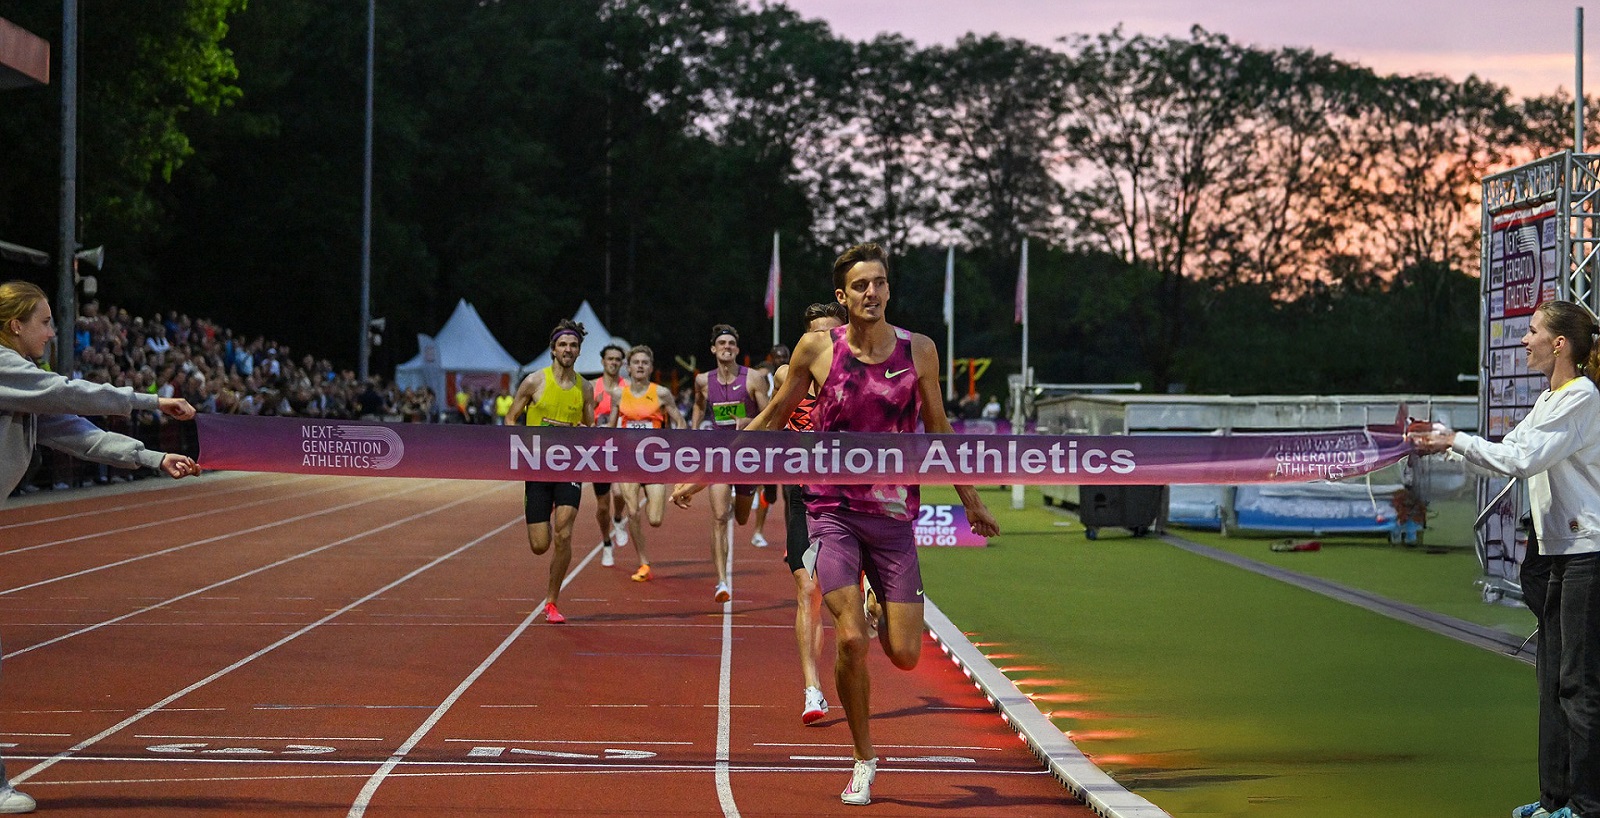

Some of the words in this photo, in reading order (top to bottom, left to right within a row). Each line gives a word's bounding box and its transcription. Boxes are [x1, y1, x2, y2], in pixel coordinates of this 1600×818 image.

[719, 405, 738, 417] 287
[302, 425, 333, 439] NEXT
[302, 440, 381, 454] GENERATION
[509, 434, 618, 472] Next
[635, 436, 904, 474] Generation
[918, 439, 1136, 474] Athletics
[302, 454, 370, 469] ATHLETICS
[1275, 451, 1356, 463] GENERATION
[1275, 463, 1344, 478] ATHLETICS
[918, 505, 953, 526] 25
[914, 526, 957, 535] meter
[914, 535, 933, 546] TO
[936, 535, 957, 546] GO
